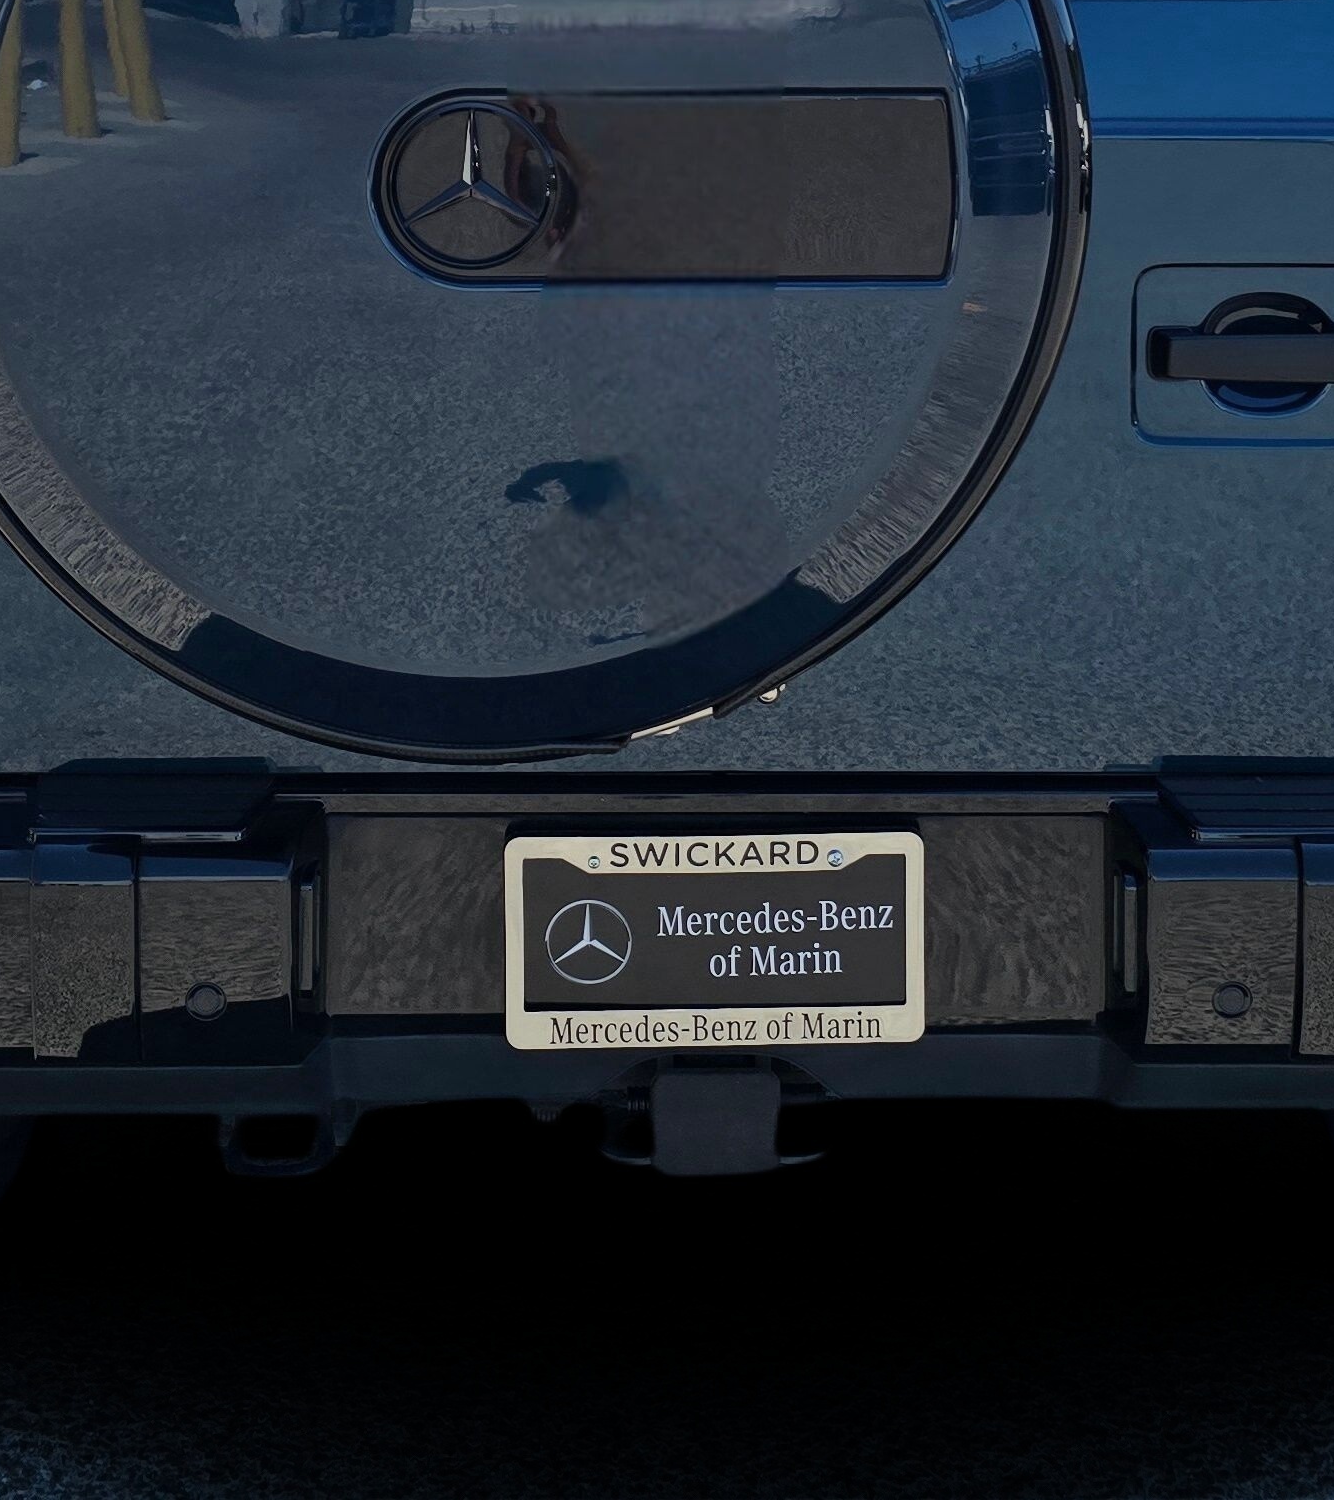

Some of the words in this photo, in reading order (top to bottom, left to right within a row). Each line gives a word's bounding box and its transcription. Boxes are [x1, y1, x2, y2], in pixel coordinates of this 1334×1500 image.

[609, 840, 820, 868] SWICKARD
[656, 901, 894, 937] Mercedes-Benz
[709, 945, 741, 978] of
[749, 942, 843, 976] Marin
[550, 1015, 757, 1045] Mercedes-Benz
[766, 1012, 794, 1041] of
[801, 1011, 882, 1040] Marin
